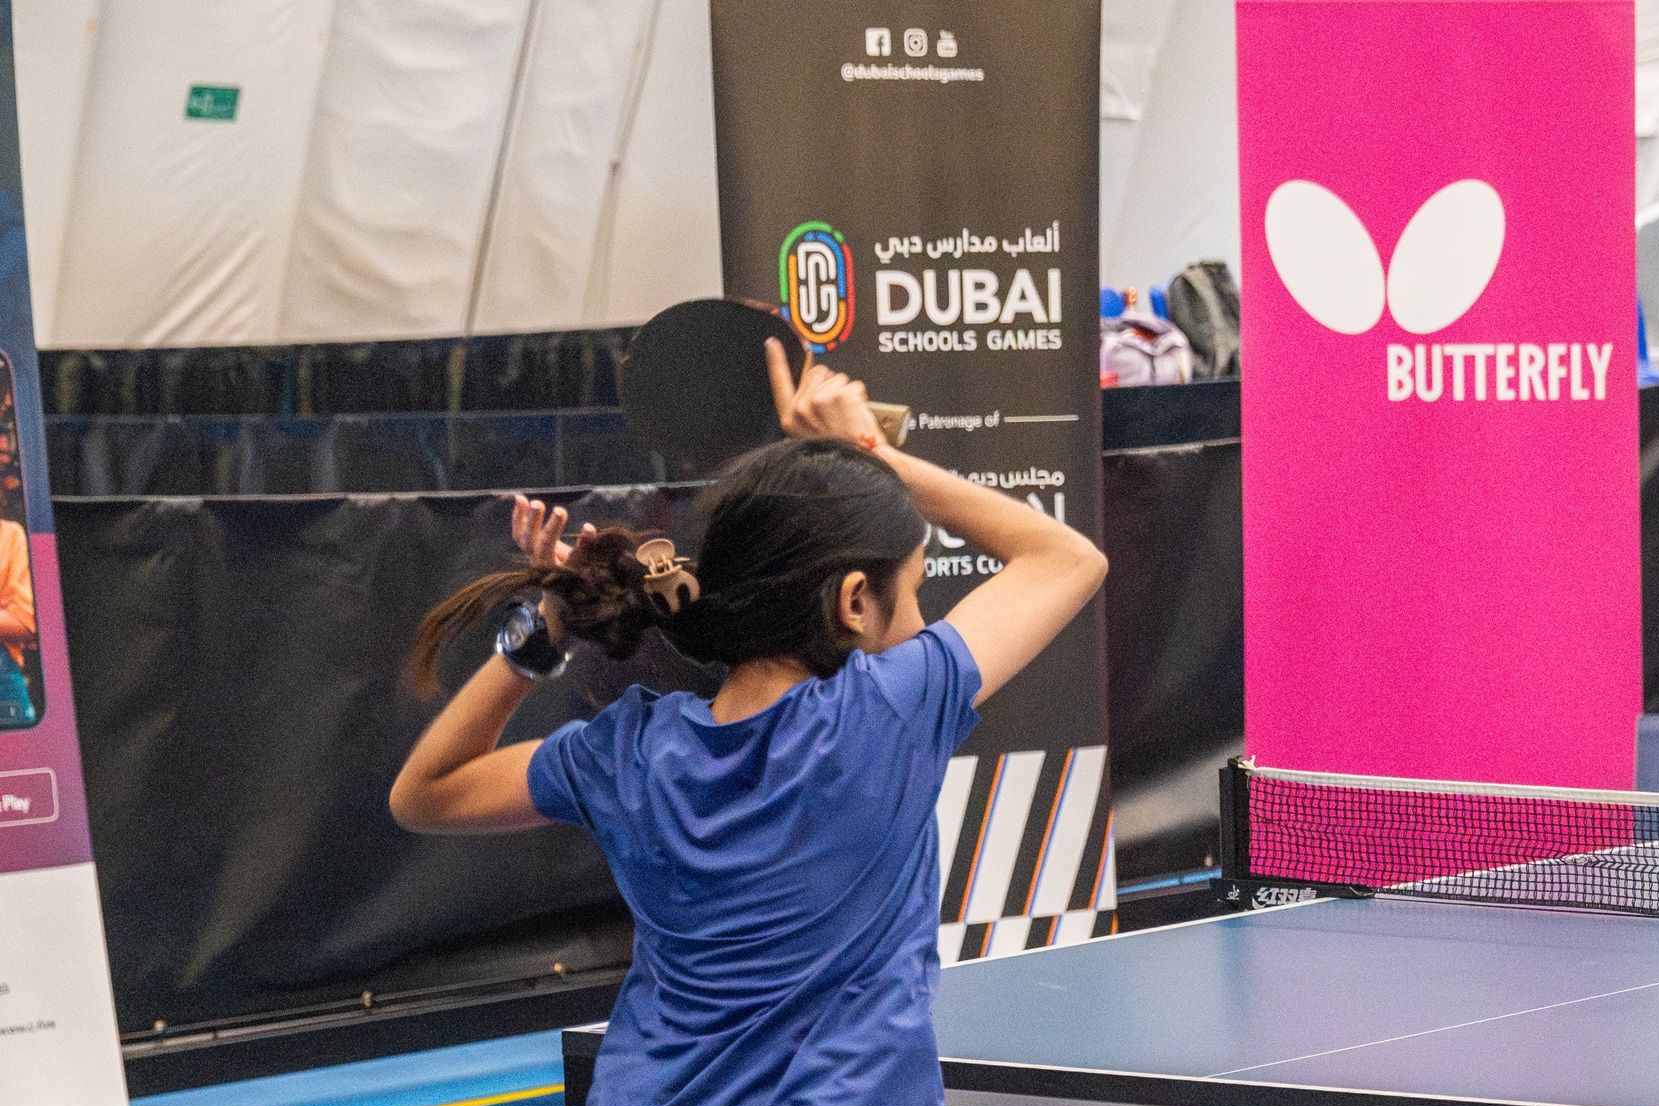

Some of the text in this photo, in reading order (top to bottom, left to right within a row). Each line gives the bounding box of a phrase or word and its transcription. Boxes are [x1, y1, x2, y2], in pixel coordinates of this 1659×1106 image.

[841, 62, 985, 84] @dubaischoolsgames
[874, 220, 1061, 264] ألعاب مدارس دبي
[875, 268, 1062, 326] DUBAI
[878, 328, 1063, 352] SCHOOLS GAMES
[1387, 342, 1614, 402] BUTTERFLY
[918, 412, 982, 431] Patronage
[984, 410, 1000, 428] of
[999, 466, 1066, 489] مجلس
